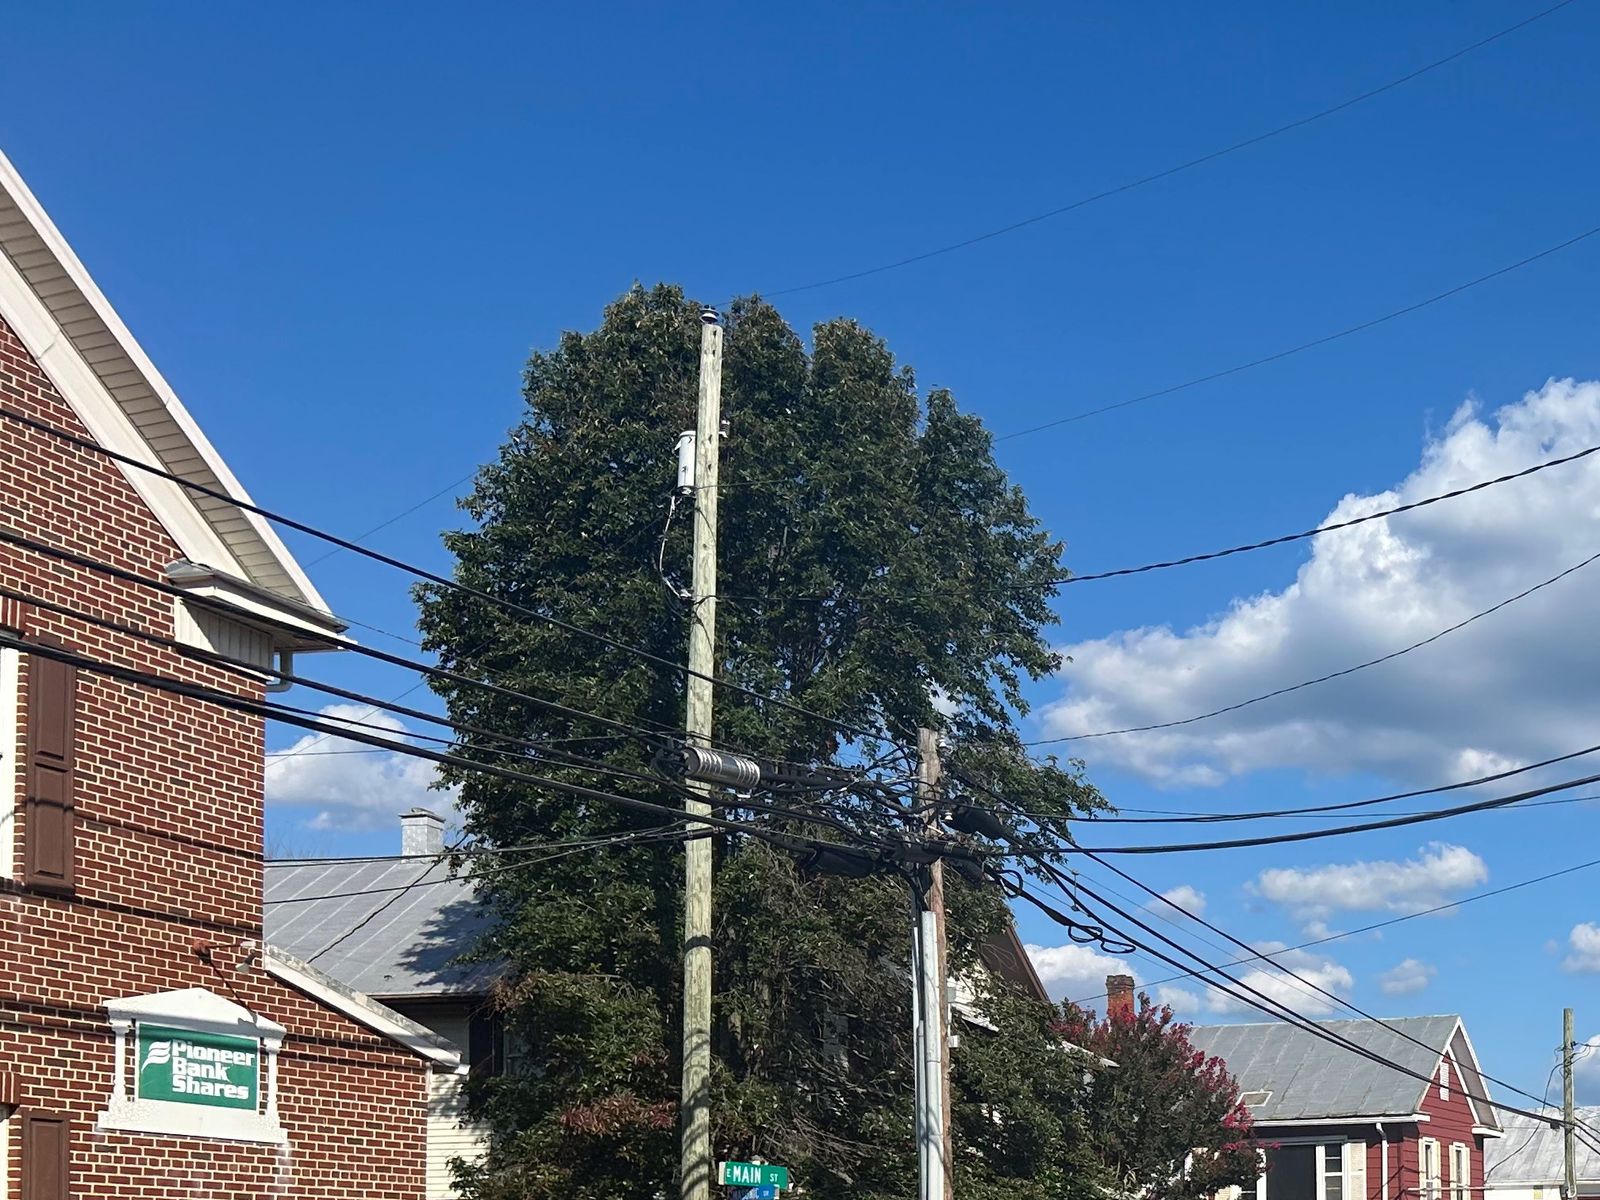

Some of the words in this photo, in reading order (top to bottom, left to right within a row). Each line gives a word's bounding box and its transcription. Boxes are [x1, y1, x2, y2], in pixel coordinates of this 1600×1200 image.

[172, 1039, 255, 1066] Pioneer
[172, 1056, 231, 1083] Bank
[172, 1074, 249, 1100] Shares
[726, 1168, 732, 1178] E
[732, 1165, 762, 1184] MAIN
[769, 1173, 779, 1182] ST
